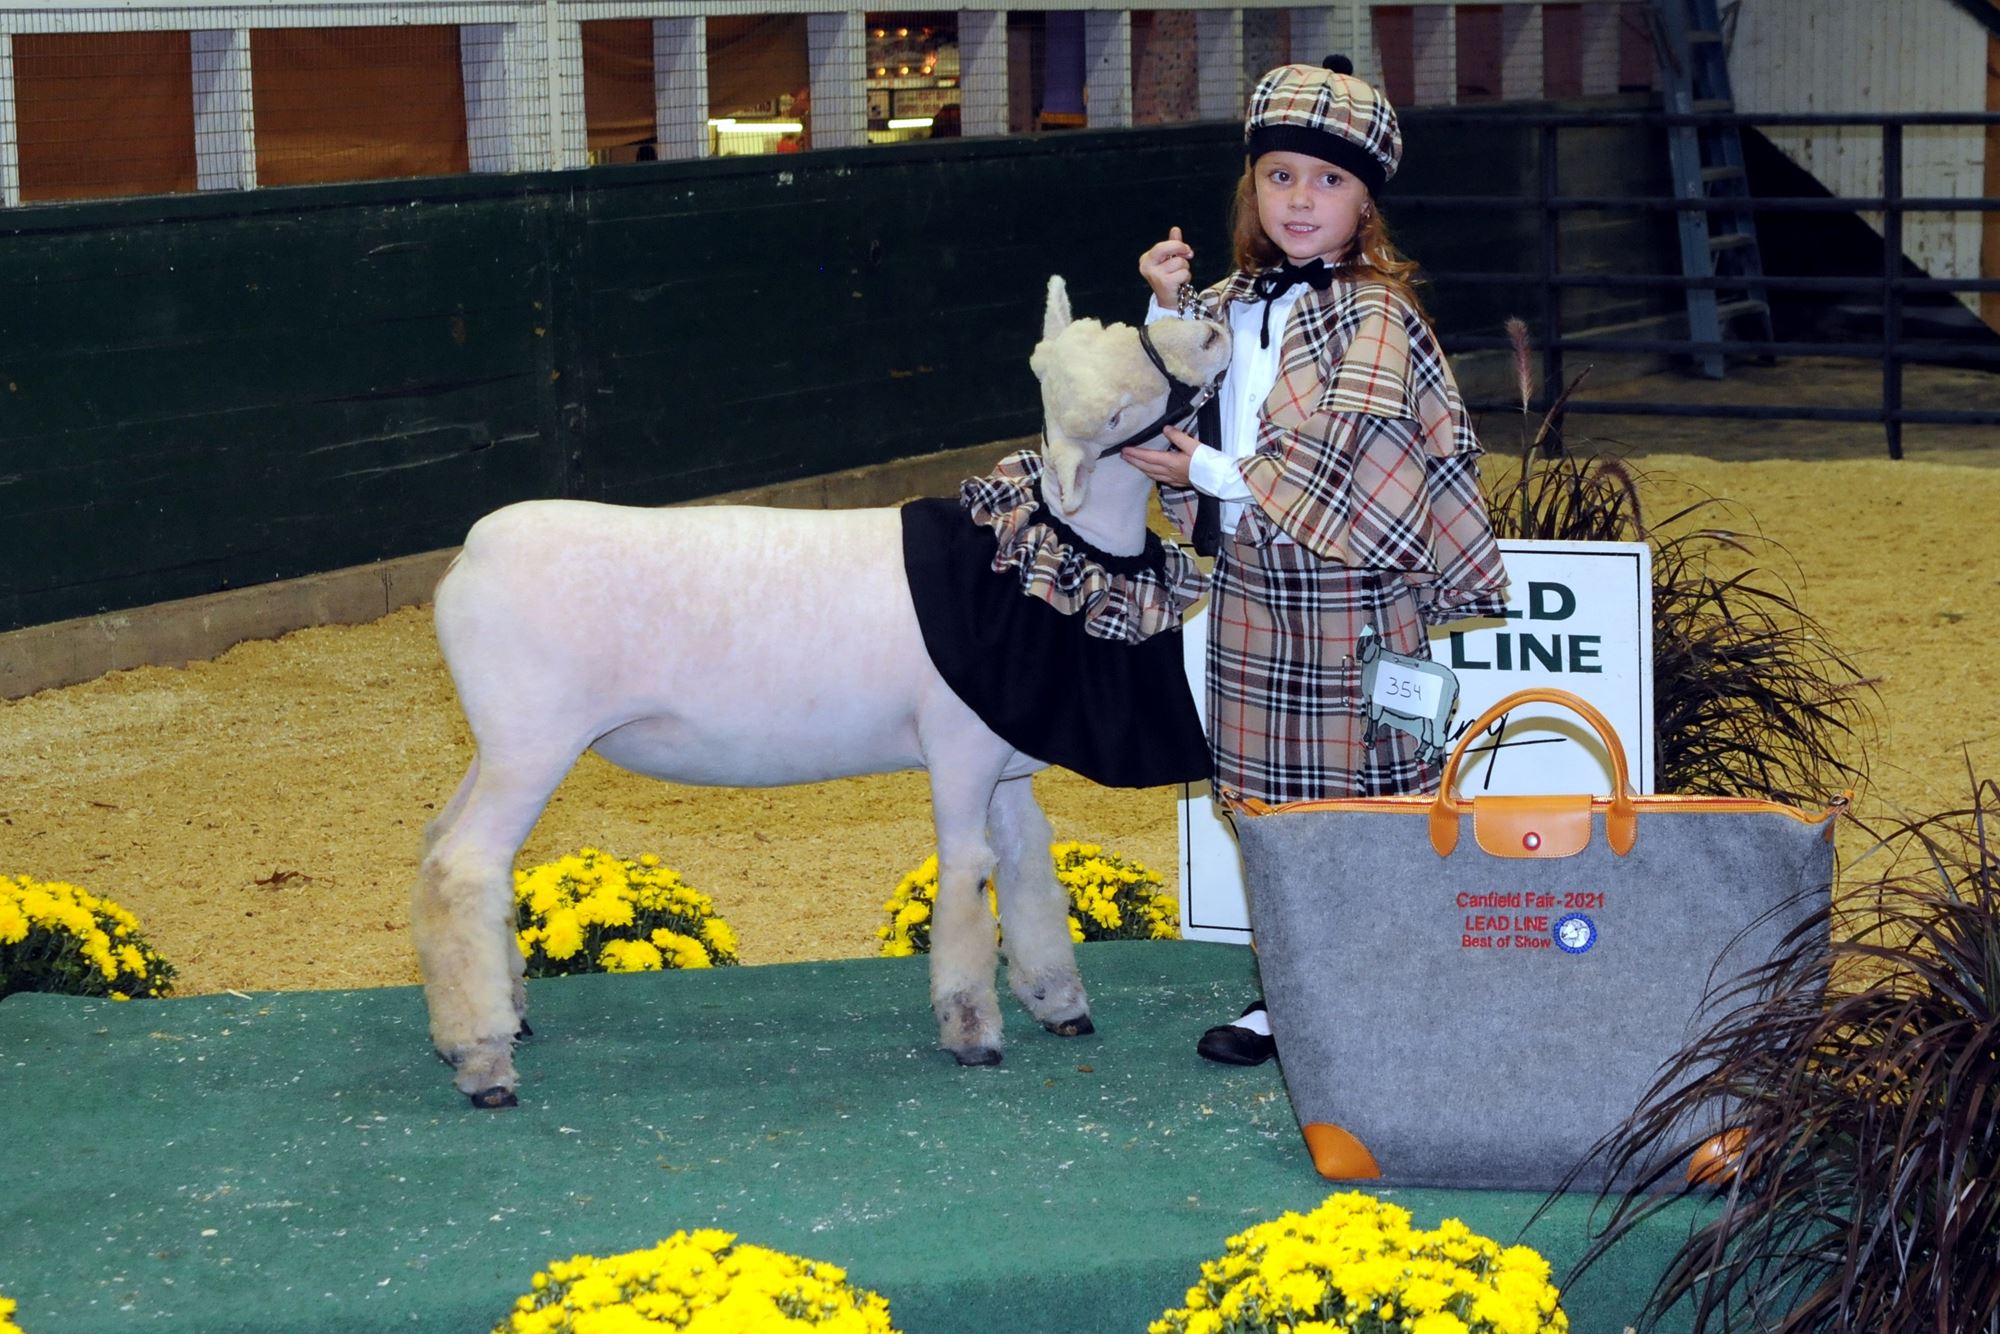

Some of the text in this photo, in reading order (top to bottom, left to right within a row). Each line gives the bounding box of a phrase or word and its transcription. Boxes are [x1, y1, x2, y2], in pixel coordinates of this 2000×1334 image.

[1450, 631, 1602, 673] LINE
[1386, 677, 1421, 701] 354
[1456, 892, 1521, 909] Canfield
[1465, 916, 1549, 932] LEAD LINE
[1462, 935, 1551, 948] Best of Show
